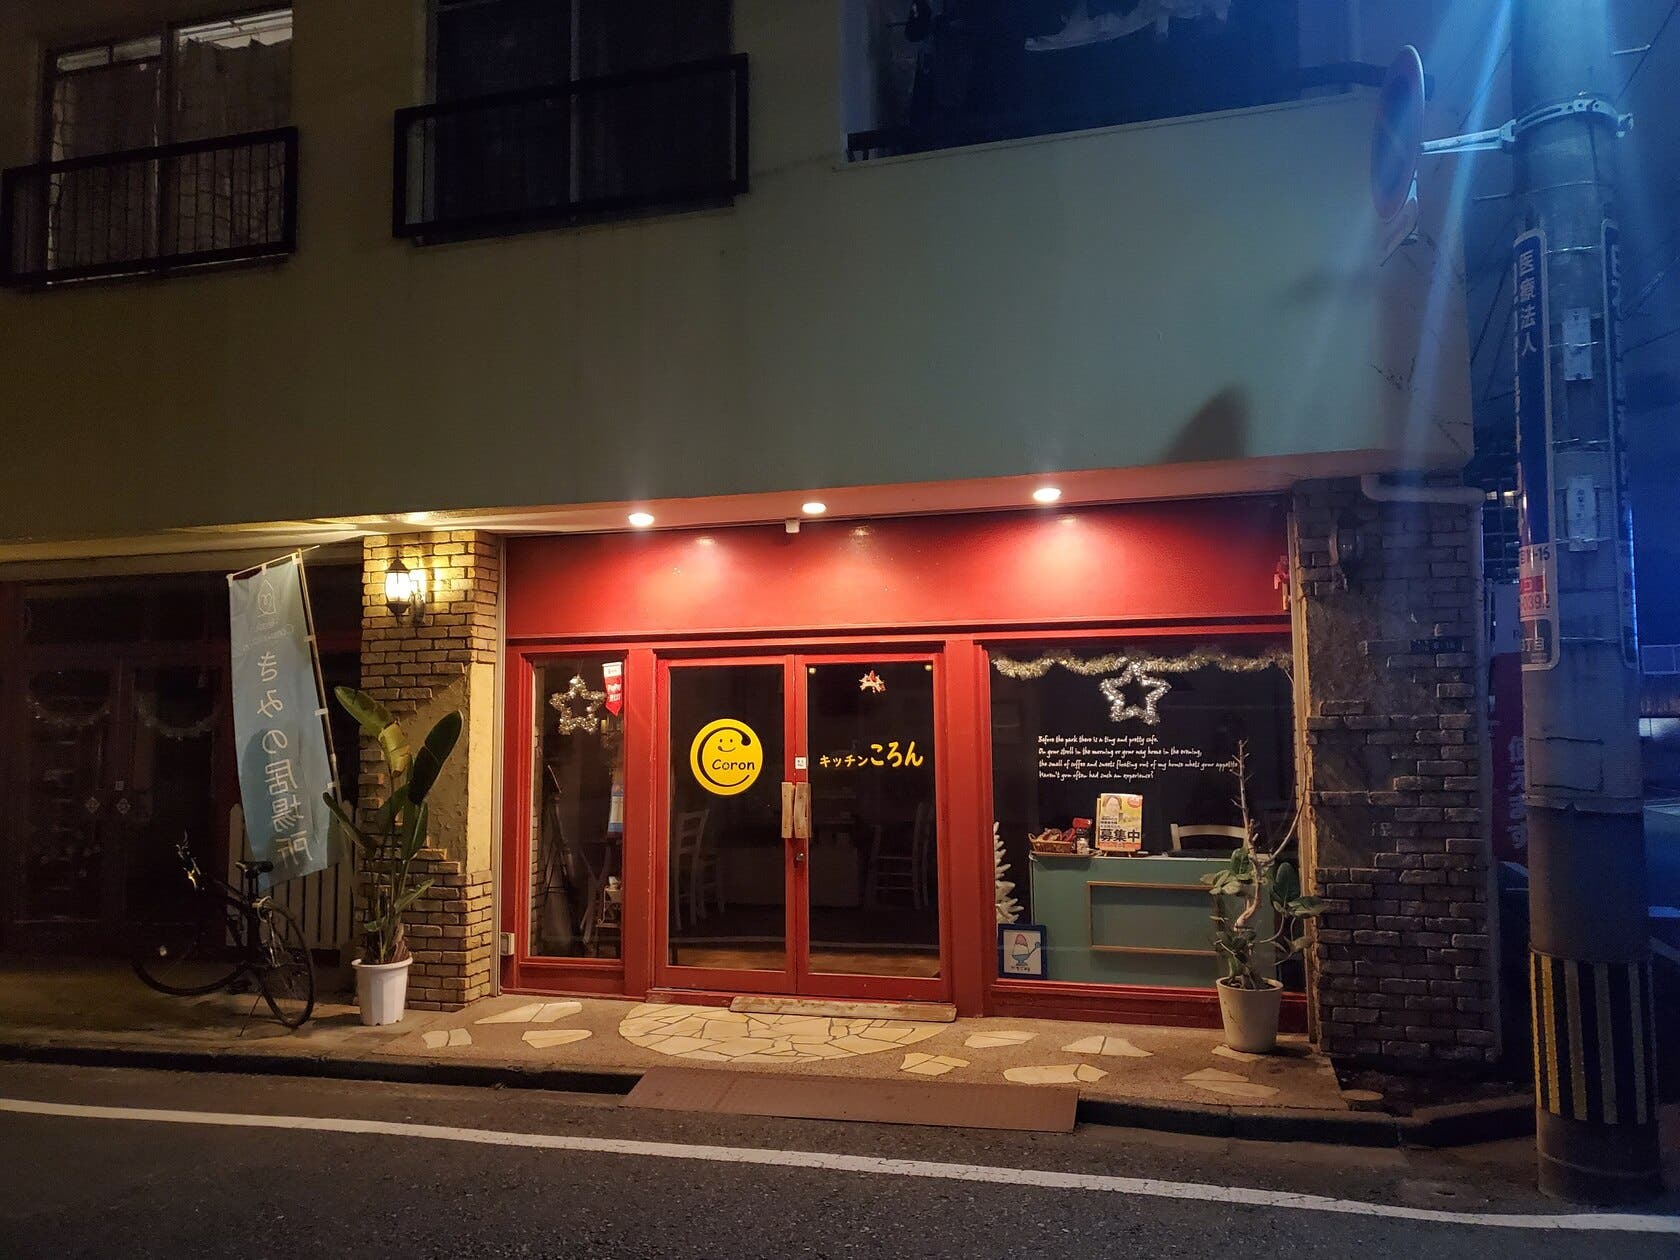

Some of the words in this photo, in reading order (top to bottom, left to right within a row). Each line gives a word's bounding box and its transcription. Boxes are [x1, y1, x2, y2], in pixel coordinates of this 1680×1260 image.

[1519, 248, 1537, 358] 医療法人
[1038, 735, 1054, 745] Before
[1055, 735, 1064, 743] the
[1065, 735, 1078, 746] park
[1079, 735, 1092, 743] there
[1104, 736, 1116, 746] tiny
[1117, 735, 1127, 743] and
[1129, 735, 1145, 746] pretty
[819, 741, 924, 768] キッチンころん
[1039, 747, 1046, 755] On
[1047, 750, 1059, 758] your
[1060, 746, 1074, 755] stroll
[1082, 746, 1091, 755] the
[1092, 748, 1114, 758] morning
[1121, 750, 1134, 758] your
[1147, 746, 1161, 755] home
[1170, 746, 1179, 755] the
[712, 758, 755, 771] Coron
[1039, 759, 1047, 767] the
[1048, 759, 1063, 767] smell
[1064, 759, 1071, 769] of
[1071, 759, 1086, 769] coffee
[1116, 759, 1138, 770] floating
[1150, 759, 1157, 769] of
[1158, 762, 1167, 771] my
[1168, 759, 1184, 767] house
[1201, 763, 1214, 771] your
[1039, 770, 1060, 778] Haven't
[1073, 770, 1088, 781] often
[1088, 770, 1099, 778] had
[1100, 770, 1113, 778] such
[1122, 770, 1154, 783] experience?
[1100, 829, 1140, 842] 募集中
